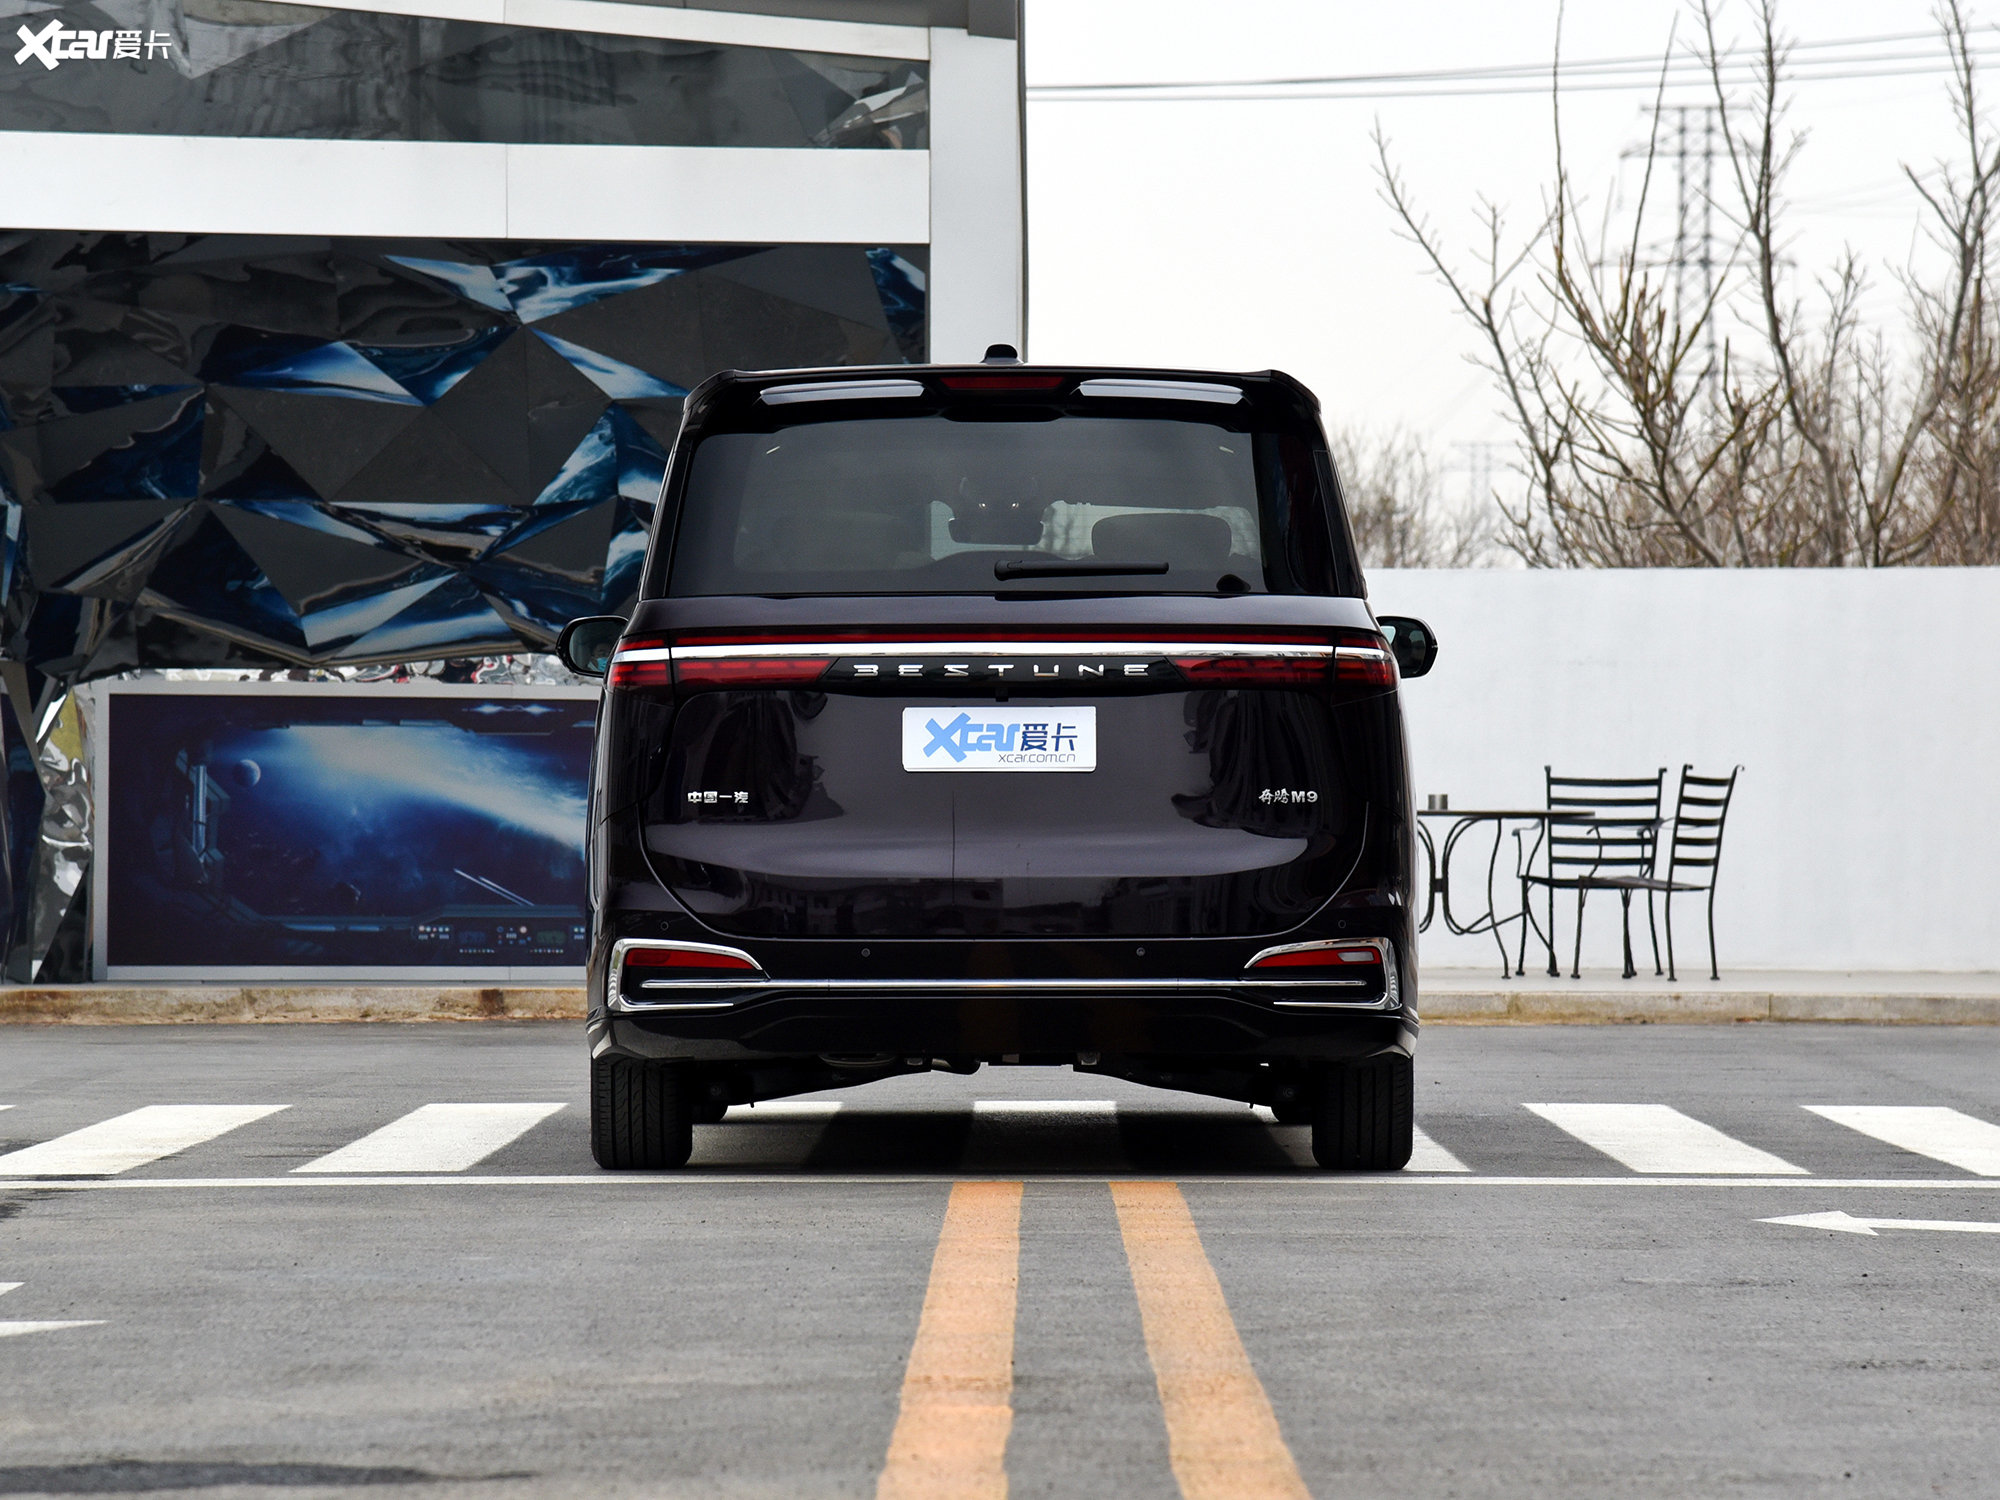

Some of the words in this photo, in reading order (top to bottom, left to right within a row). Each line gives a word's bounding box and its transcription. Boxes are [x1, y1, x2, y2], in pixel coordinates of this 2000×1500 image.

[853, 663, 1149, 677] BESTUNE
[687, 791, 749, 804] 中国一汽
